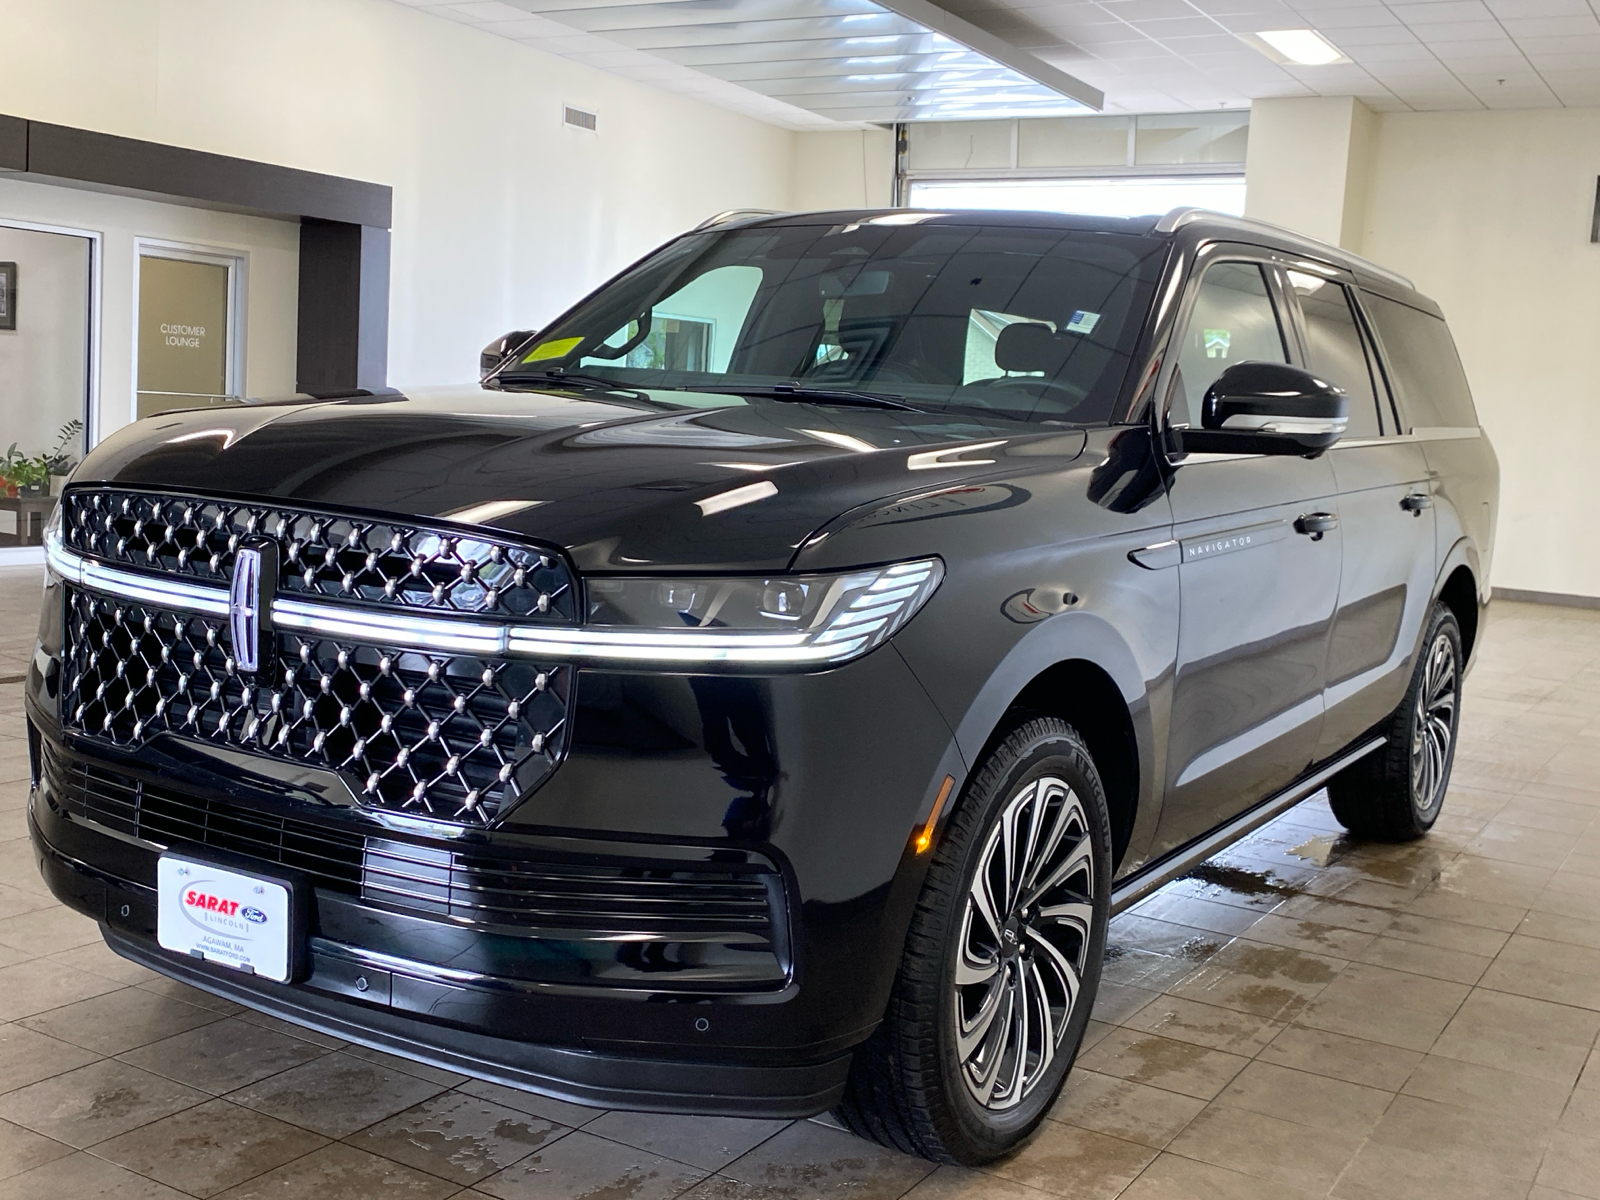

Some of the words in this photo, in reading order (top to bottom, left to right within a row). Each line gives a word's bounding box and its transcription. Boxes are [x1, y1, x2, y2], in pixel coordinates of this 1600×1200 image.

[160, 323, 206, 336] CUSTOMER
[165, 335, 200, 348] LOUNGE
[1189, 536, 1251, 557] NAVIGATOR
[185, 891, 239, 917] SARAT
[244, 908, 265, 923] Ford
[210, 915, 244, 930] LINCOLN
[202, 935, 233, 951] AGAWAM,
[234, 944, 245, 954] MA
